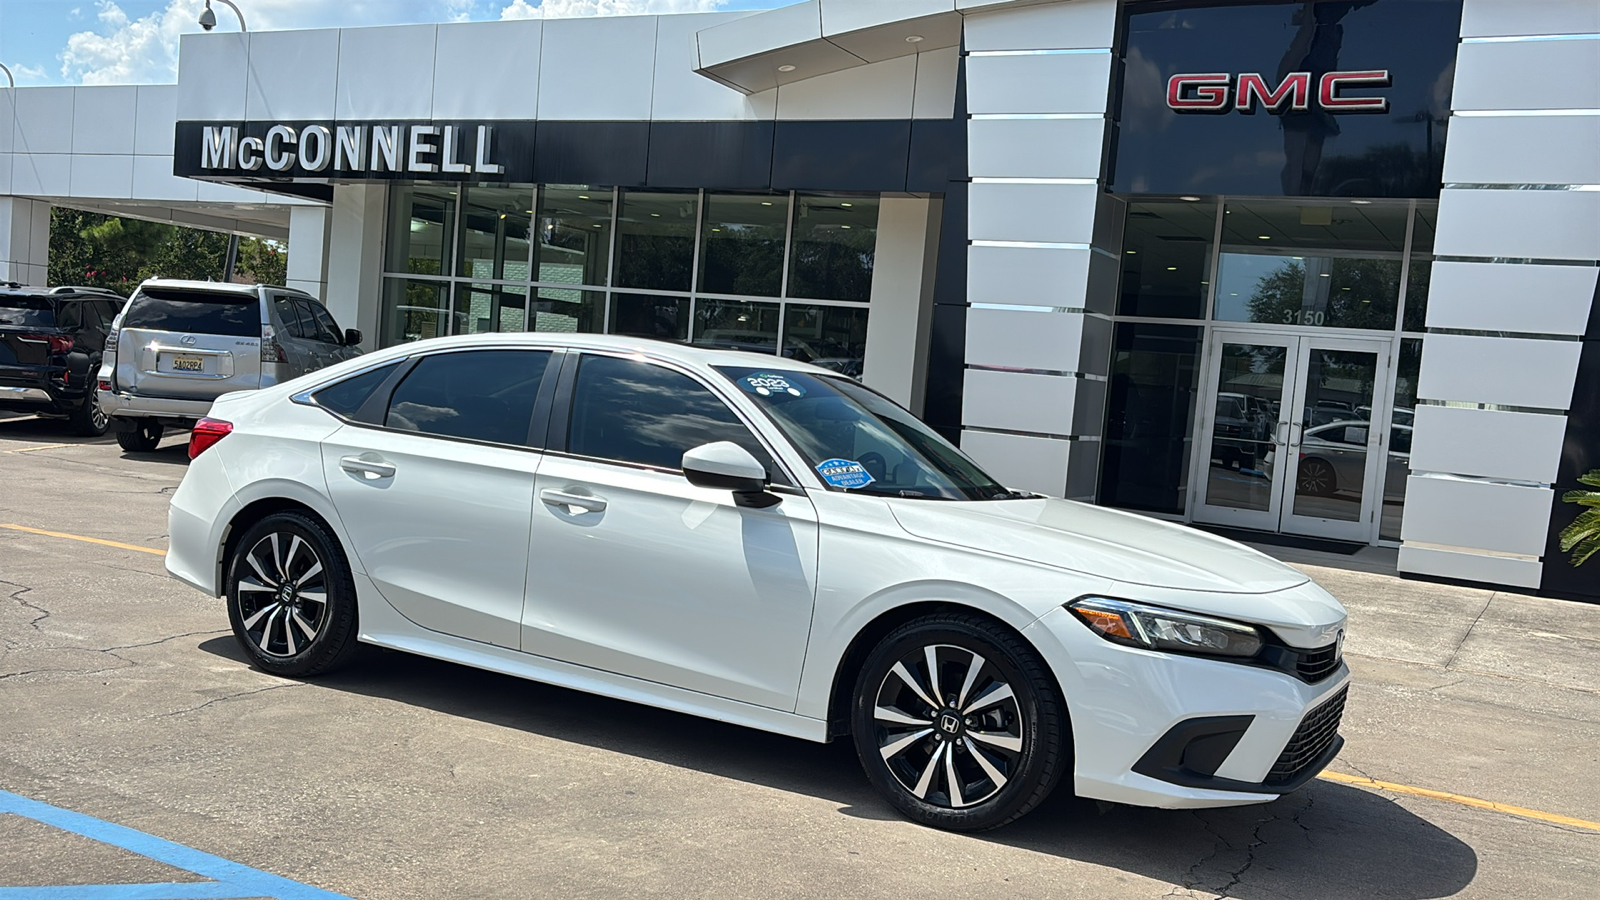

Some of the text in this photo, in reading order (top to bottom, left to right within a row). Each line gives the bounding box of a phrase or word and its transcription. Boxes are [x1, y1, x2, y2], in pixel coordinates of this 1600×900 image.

[1166, 70, 1389, 111] GMC
[1282, 309, 1325, 326] 3150
[831, 473, 865, 481] ADVANTAGE
[841, 478, 865, 486] DEALER
